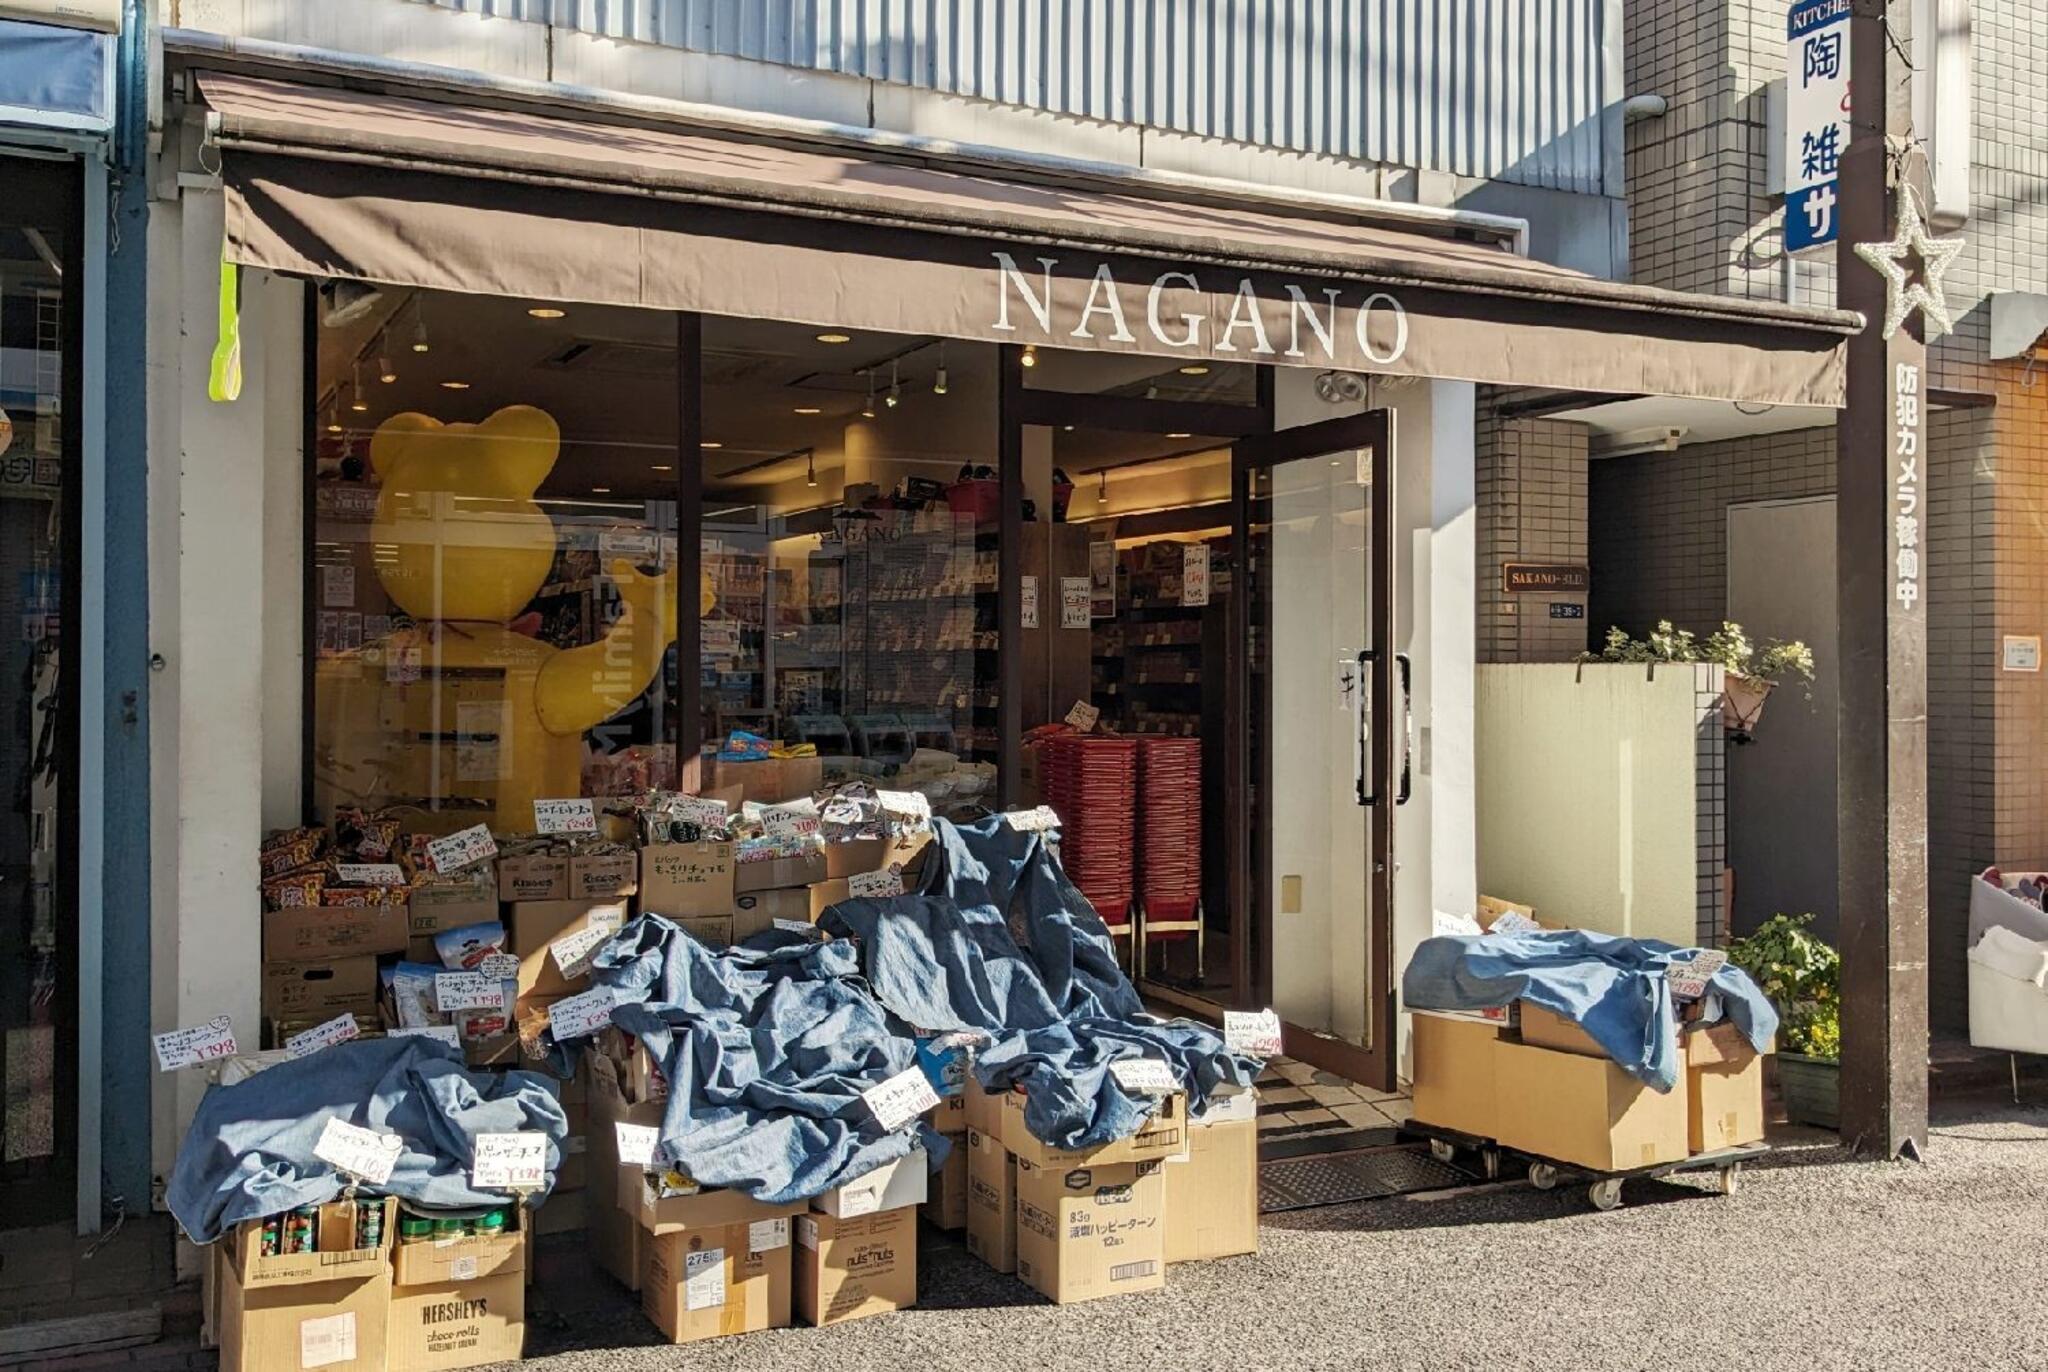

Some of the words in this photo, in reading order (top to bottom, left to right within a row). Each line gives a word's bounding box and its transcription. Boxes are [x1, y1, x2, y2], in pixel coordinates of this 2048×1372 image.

[991, 250, 1409, 364] NAGANO
[1895, 362, 1919, 610] 防犯カメラ稼働中
[422, 1297, 487, 1326] HERSHEY'S
